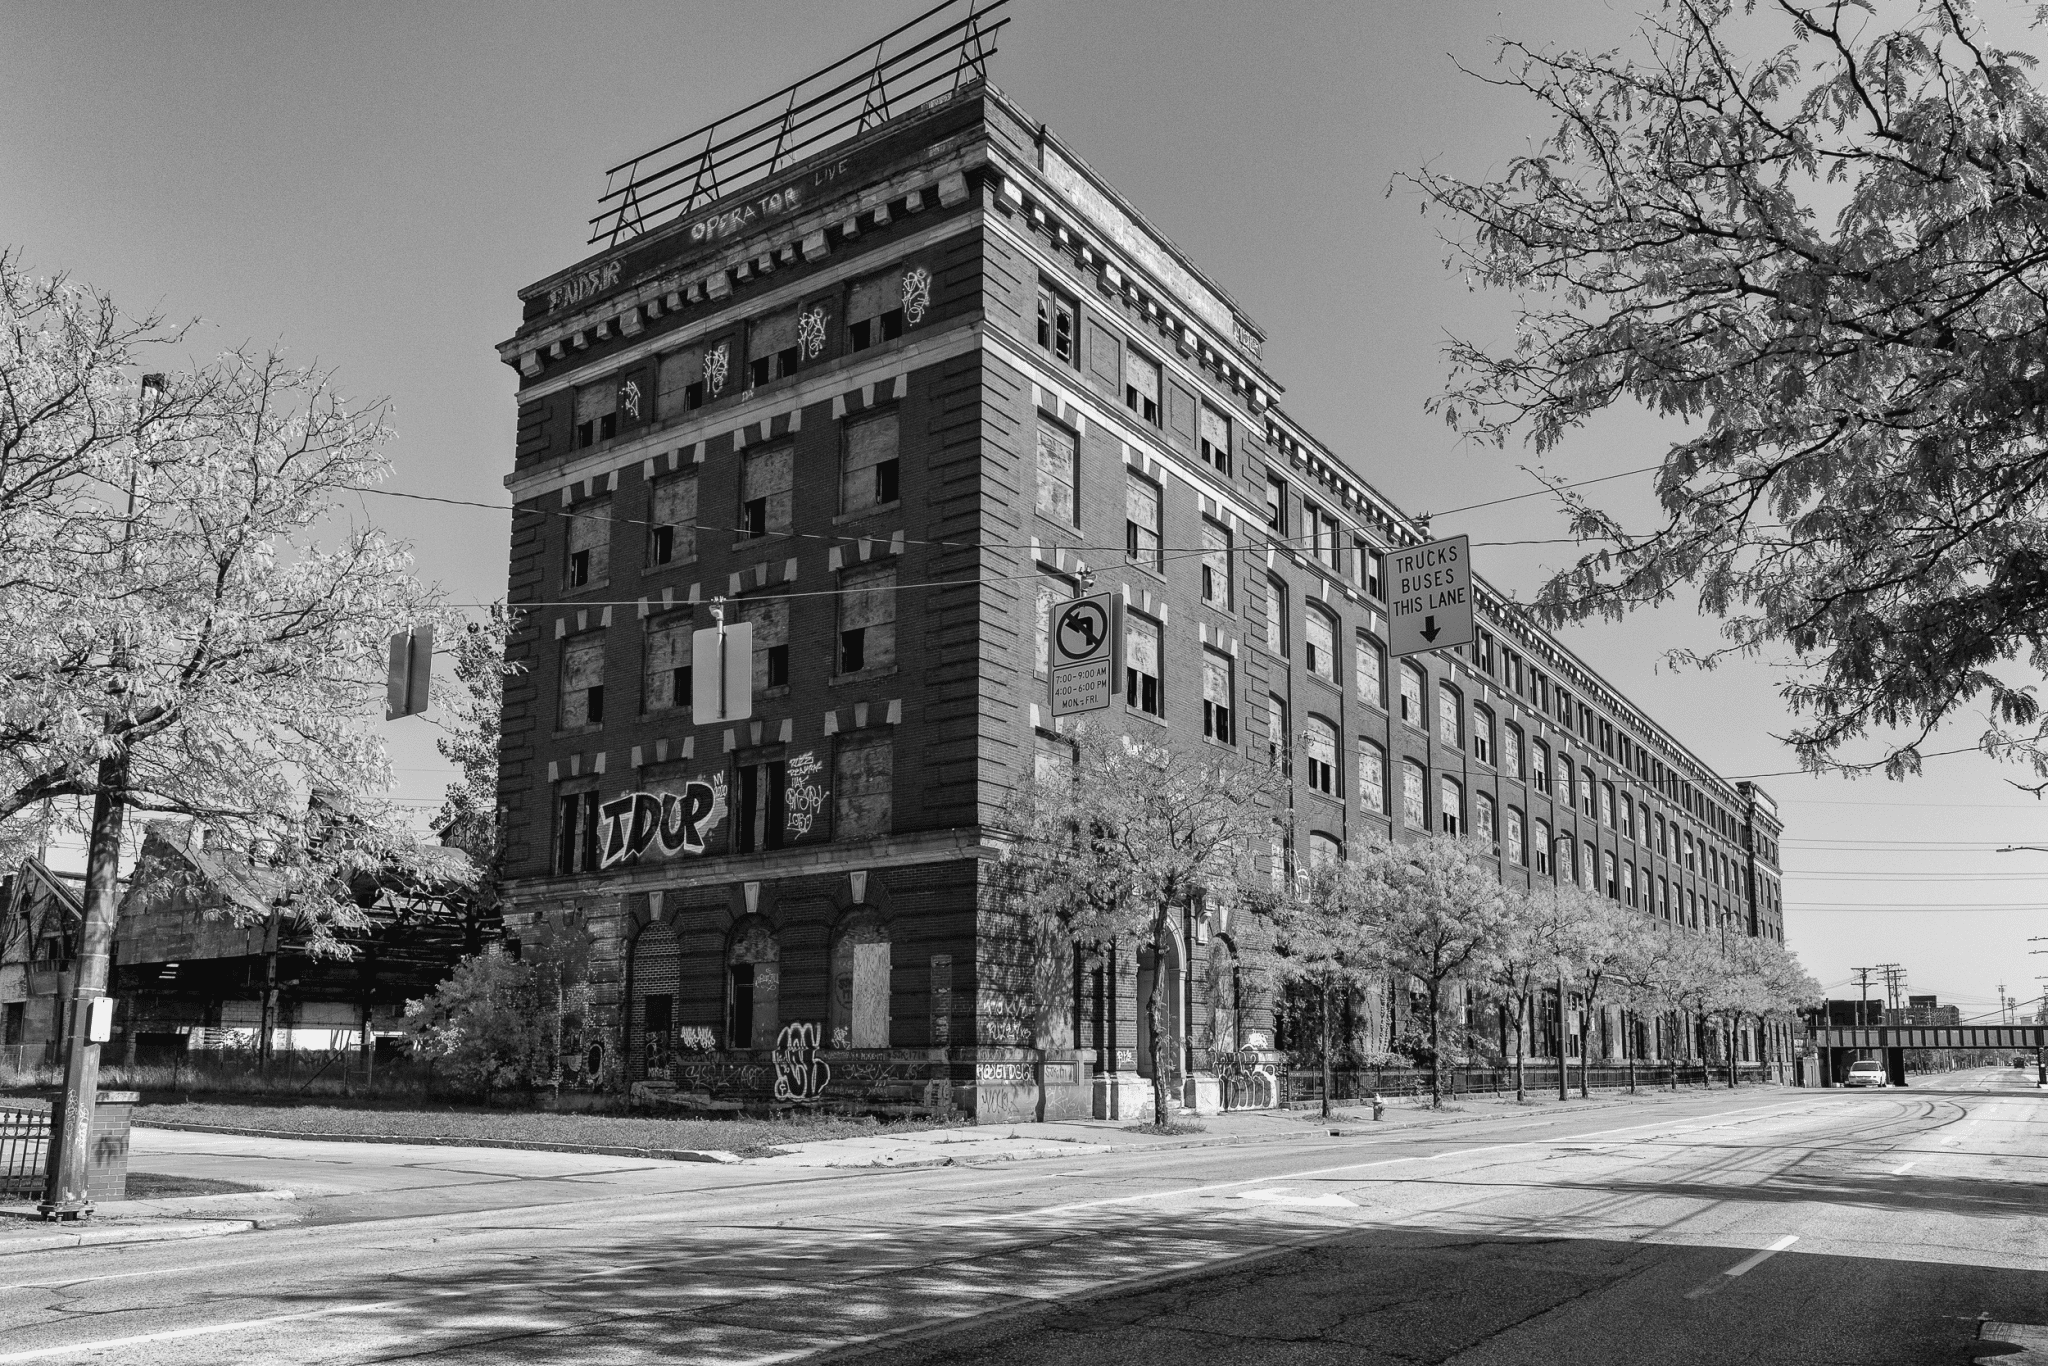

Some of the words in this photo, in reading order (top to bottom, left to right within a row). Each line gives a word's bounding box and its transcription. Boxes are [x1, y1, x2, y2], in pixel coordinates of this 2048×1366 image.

[814, 159, 848, 186] LIVE
[1396, 545, 1458, 574] TRUCKS
[1401, 568, 1454, 594] BUSES
[1393, 596, 1423, 617] THIS
[1429, 587, 1466, 610] LANE
[1096, 666, 1107, 677] AM
[1096, 679, 1107, 690] PM
